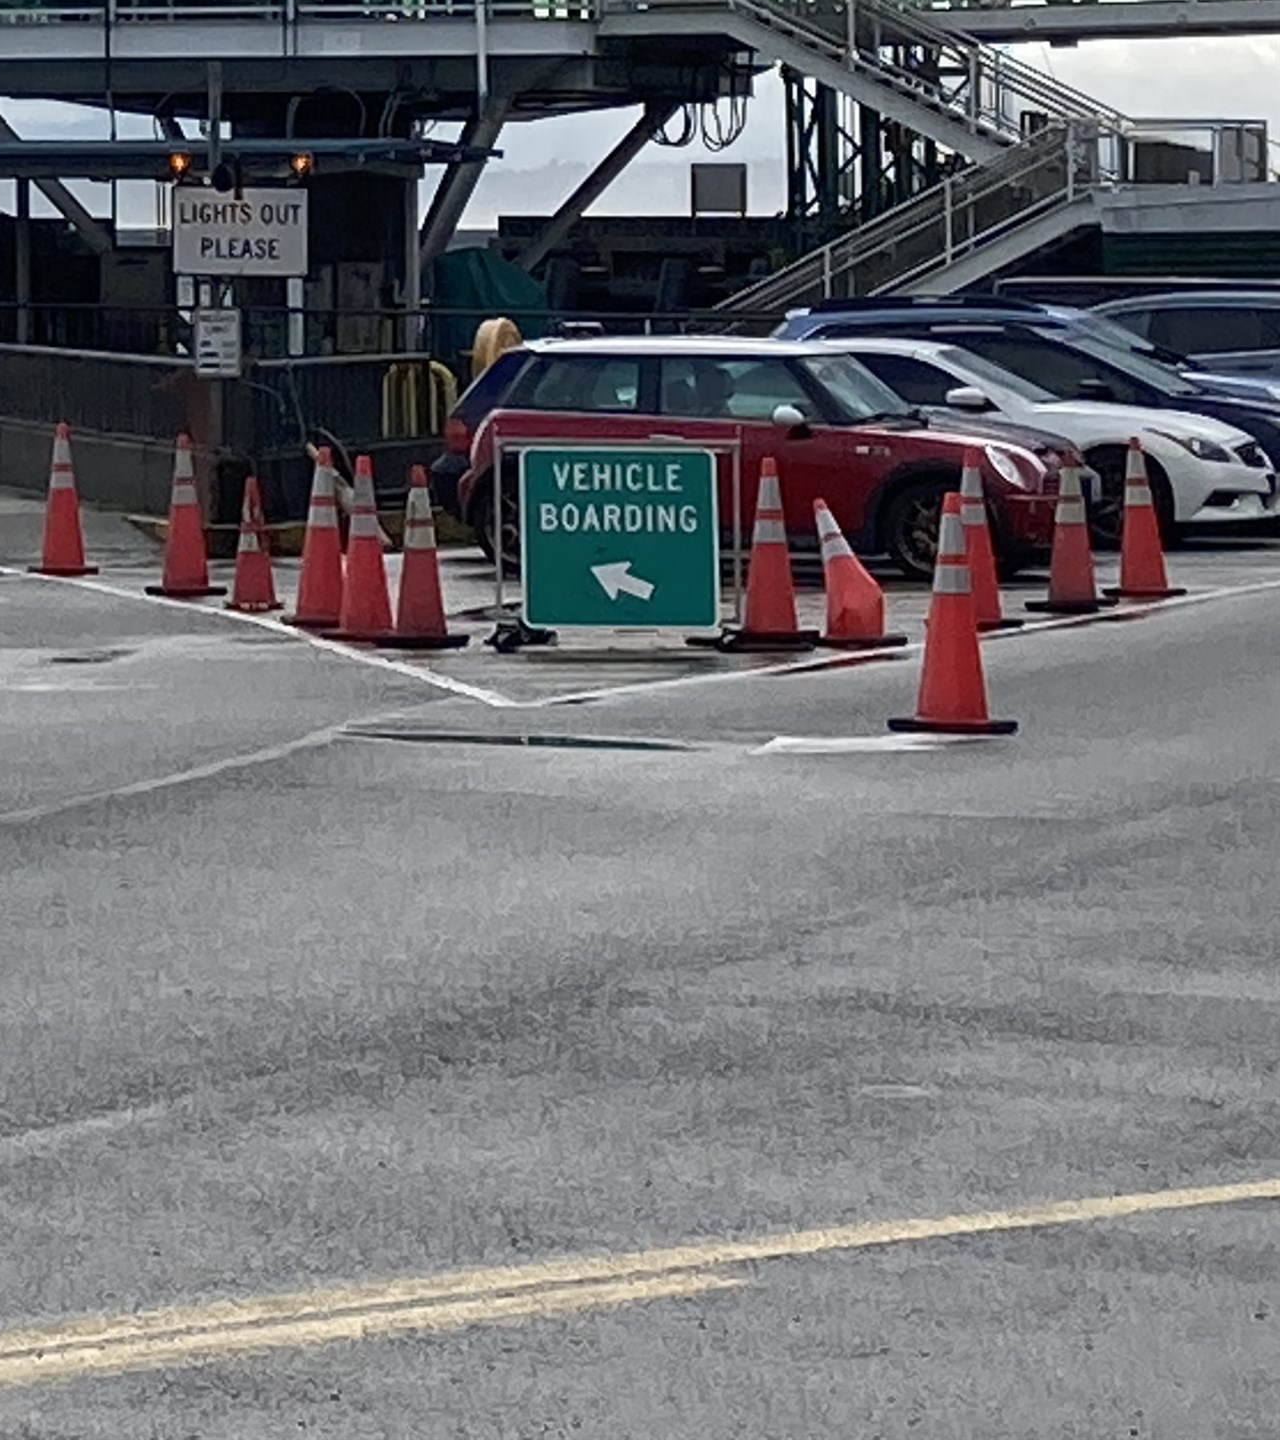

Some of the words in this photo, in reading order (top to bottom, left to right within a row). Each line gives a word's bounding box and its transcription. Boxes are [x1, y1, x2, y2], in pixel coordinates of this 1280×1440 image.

[180, 202, 253, 225] LIGHTS
[260, 203, 301, 225] OUT
[200, 236, 280, 259] PLEASE
[552, 462, 683, 492] VEHICLE
[540, 503, 697, 533] BOARDING
